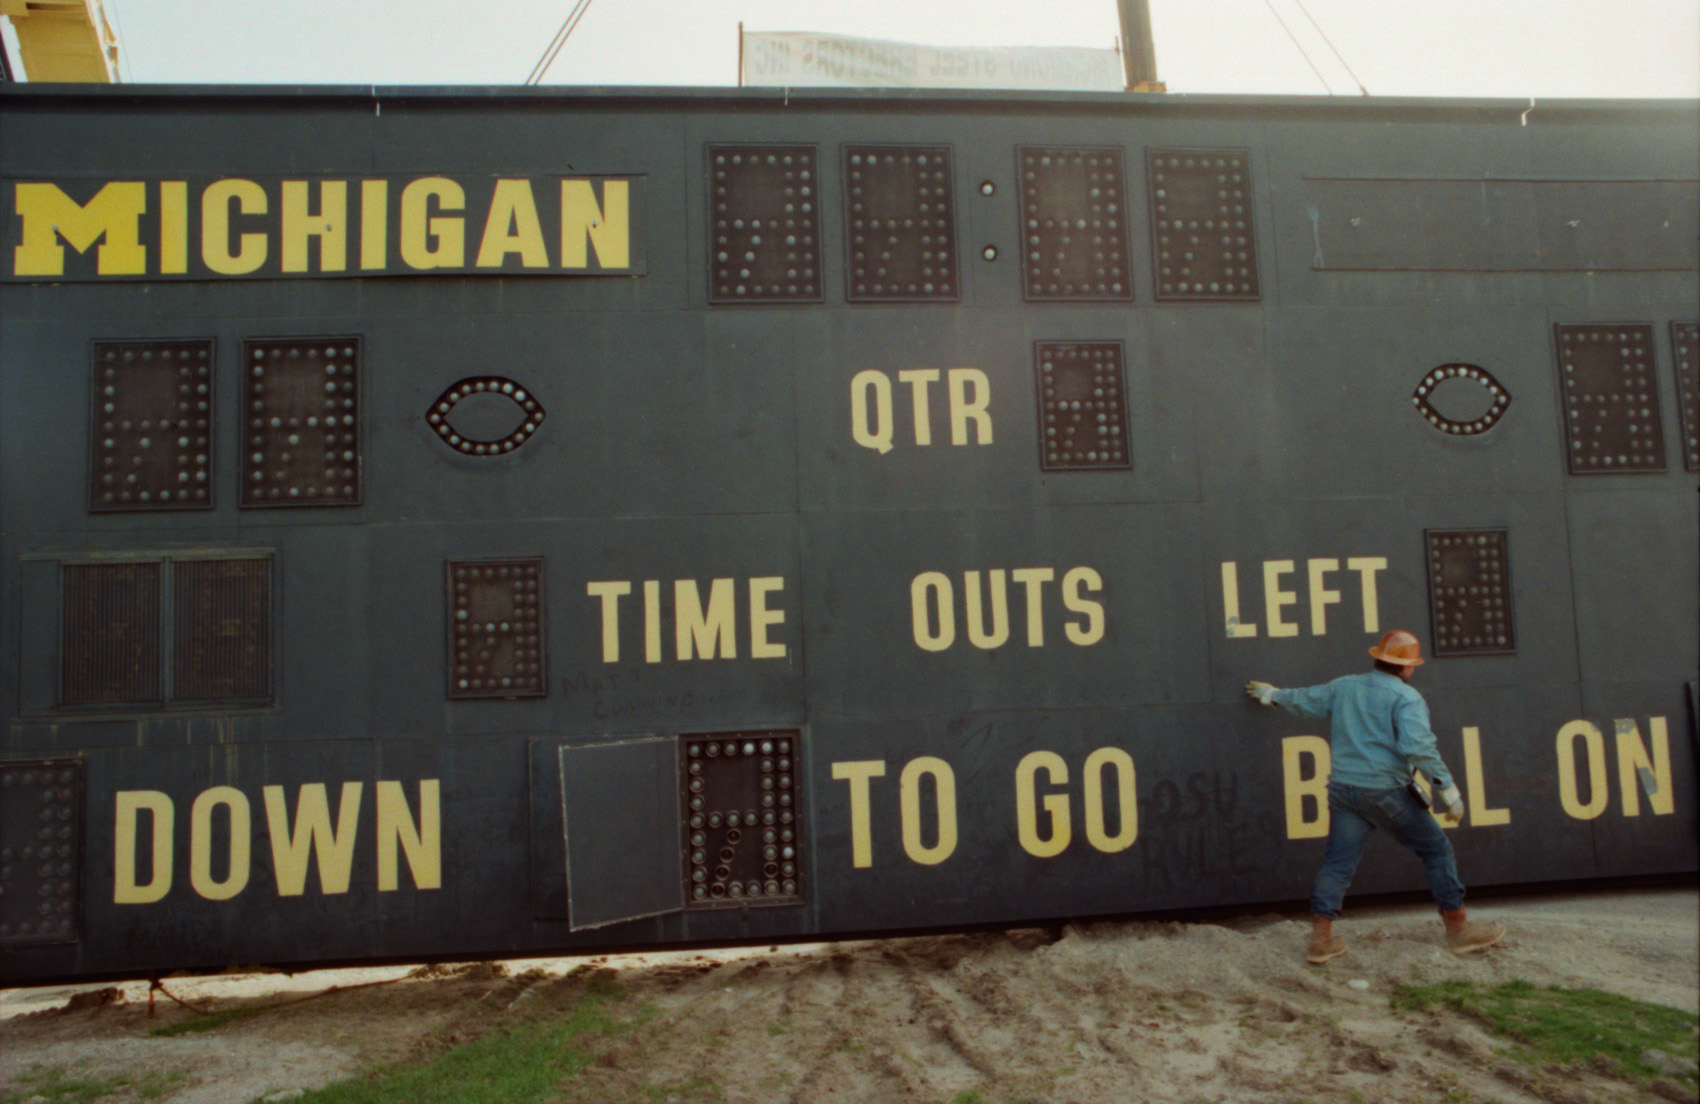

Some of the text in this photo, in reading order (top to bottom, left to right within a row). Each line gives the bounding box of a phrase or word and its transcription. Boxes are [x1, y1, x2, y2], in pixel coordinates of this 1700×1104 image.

[14, 176, 630, 276] MICHIGAN
[850, 366, 993, 455] QTR
[586, 557, 1388, 664] TIME OUTS LEFT
[831, 746, 1138, 868] TO GO
[1282, 717, 1674, 839] BL ON
[114, 778, 441, 904] DOWN
